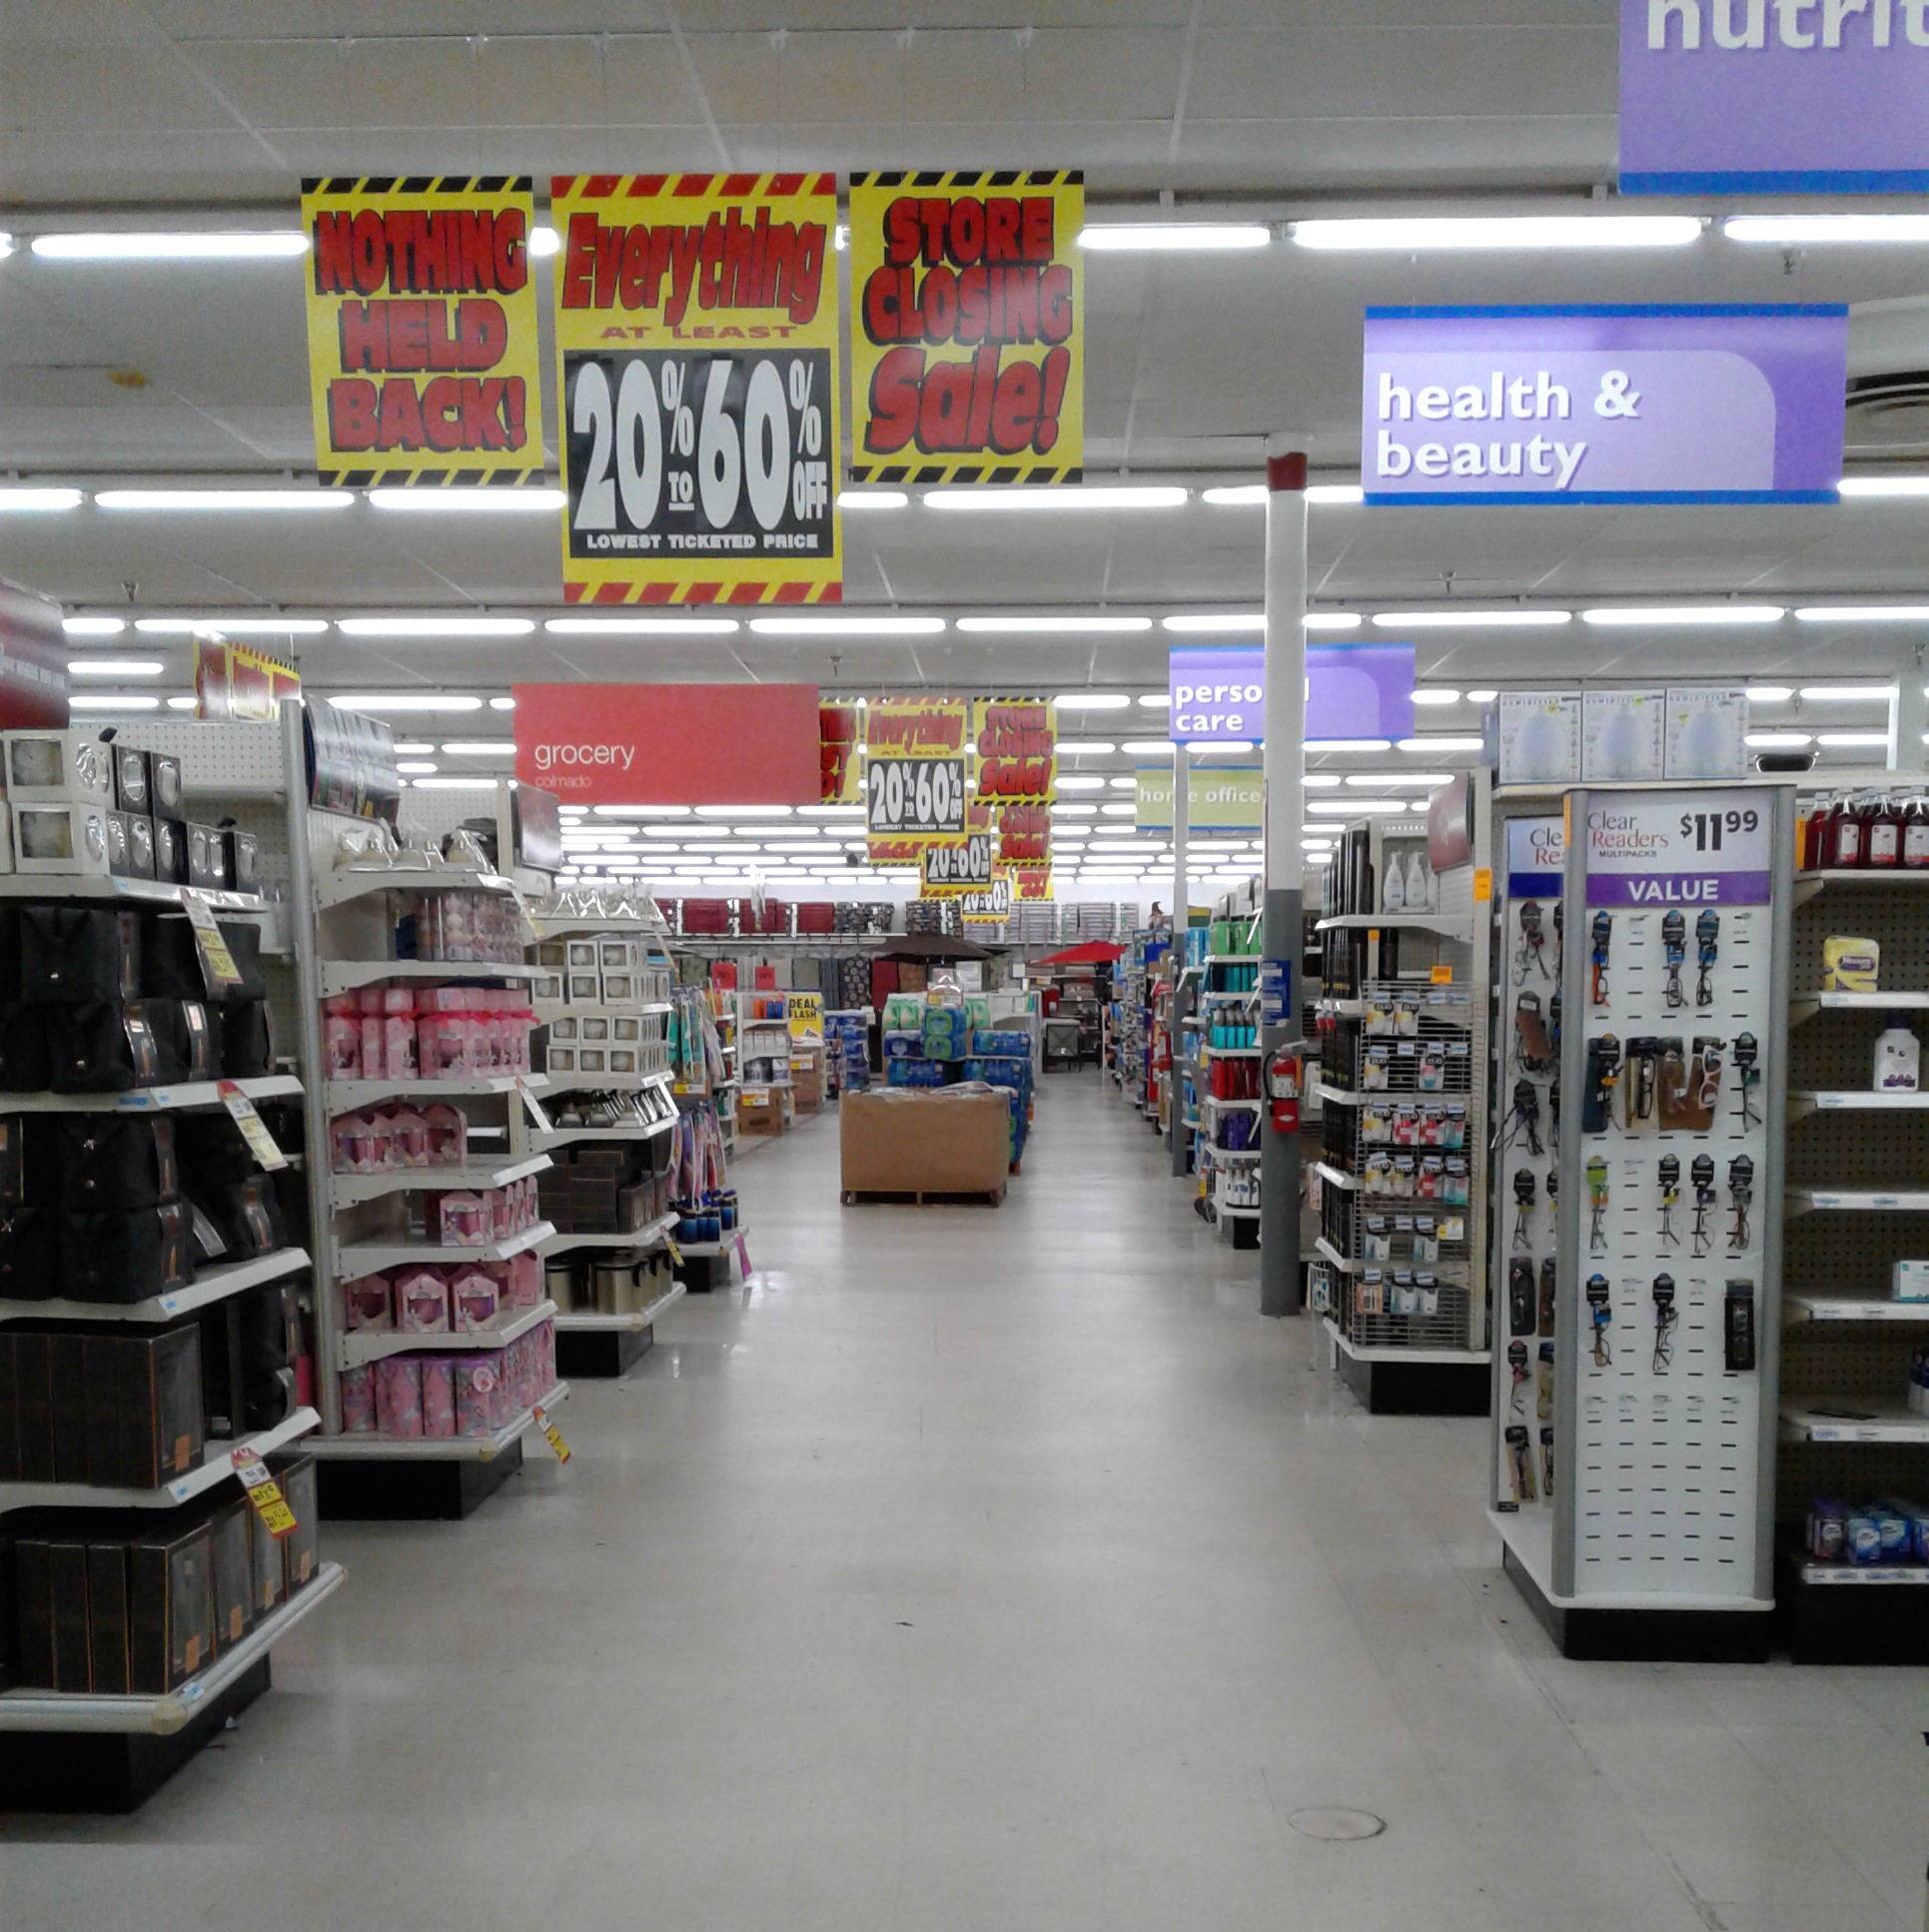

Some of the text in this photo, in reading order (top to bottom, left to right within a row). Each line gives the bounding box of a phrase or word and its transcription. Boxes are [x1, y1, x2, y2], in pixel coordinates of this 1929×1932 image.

[884, 196, 1056, 268] STORE
[315, 209, 527, 295] NOTHING
[562, 207, 827, 326] Everything
[862, 265, 1074, 346] CLOSING
[341, 299, 508, 373] HELD
[600, 326, 798, 340] AT LEAST
[863, 345, 1071, 456] Sale!
[1379, 369, 1641, 421] health &
[331, 376, 528, 455] BACK!
[572, 359, 694, 530] 20%
[697, 359, 821, 530] 60%
[792, 461, 827, 521] OFF
[1378, 430, 1588, 489] beauty
[586, 533, 818, 550] LOWEST TICKETED PRICE
[868, 708, 963, 752] Everything
[986, 705, 1047, 730] STORE
[1176, 712, 1244, 732] care
[534, 742, 636, 770] grocery
[978, 729, 1054, 758] CLOSING
[534, 773, 592, 789] colmado
[979, 756, 1053, 797] Sale!
[1205, 785, 1263, 804] office
[1587, 810, 1637, 830] Clear
[1530, 828, 1564, 847] Cle
[1592, 829, 1669, 848] Readers
[1628, 879, 1719, 902] VALUE
[789, 998, 815, 1008] DEAL
